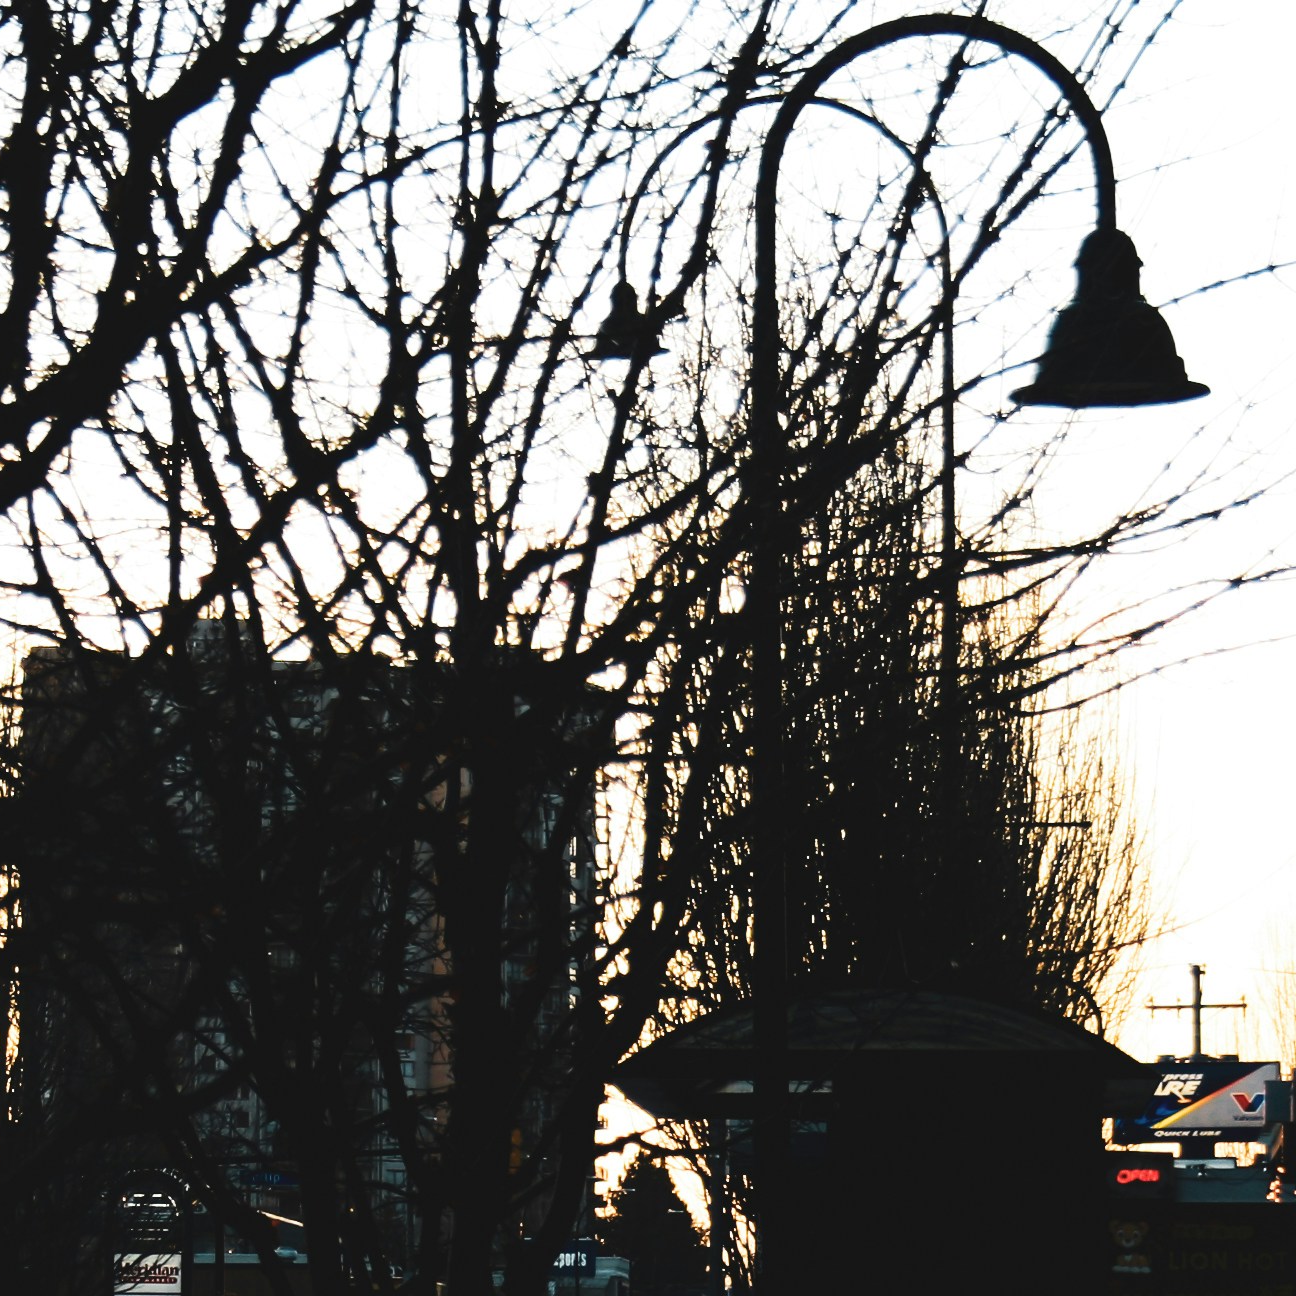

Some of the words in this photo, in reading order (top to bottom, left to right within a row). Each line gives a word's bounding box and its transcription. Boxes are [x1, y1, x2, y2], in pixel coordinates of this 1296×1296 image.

[1154, 1080, 1202, 1101] ARE
[1116, 1168, 1161, 1185] OPEN
[1168, 1251, 1227, 1271] LION
[1238, 1251, 1288, 1271] HOT
